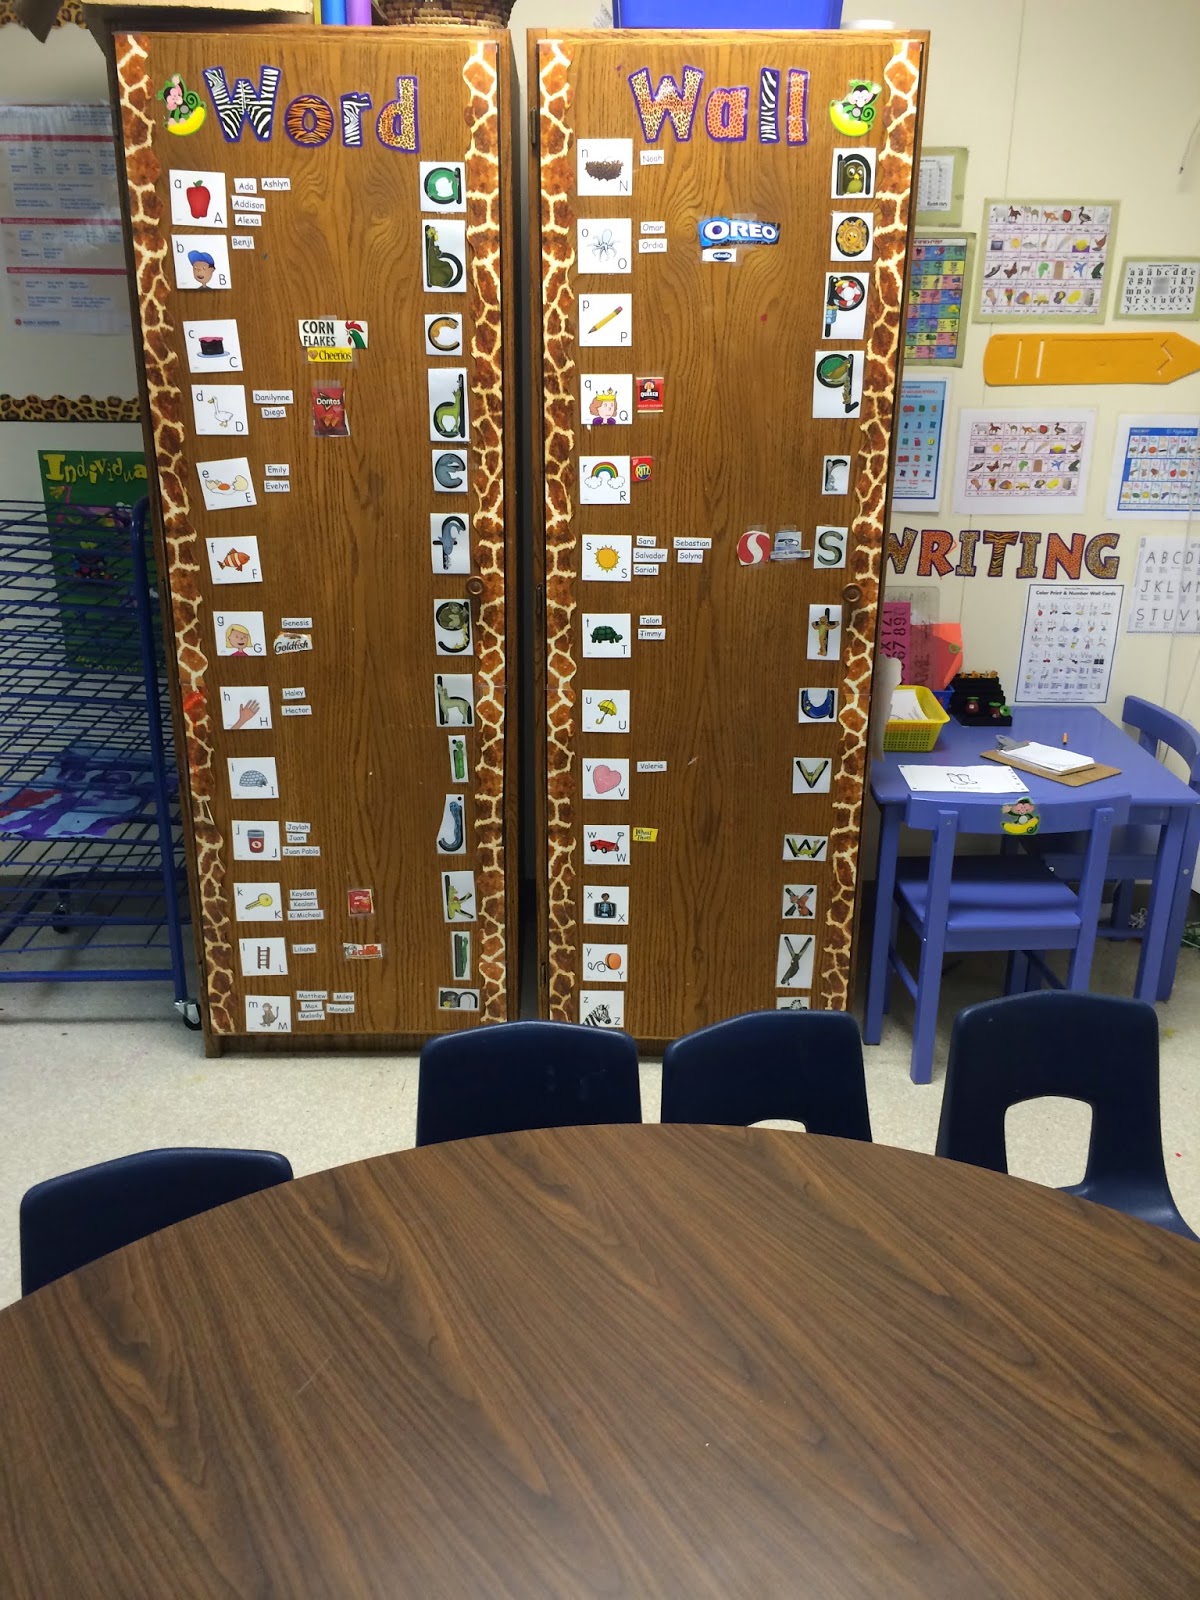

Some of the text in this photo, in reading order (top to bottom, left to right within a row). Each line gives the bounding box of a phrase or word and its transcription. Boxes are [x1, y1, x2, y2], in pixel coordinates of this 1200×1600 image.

[202, 65, 420, 153] Word
[627, 65, 810, 146] Wall
[581, 149, 589, 158] n
[642, 154, 663, 163] Noah
[174, 179, 182, 189] a
[238, 183, 254, 191] Ada
[263, 180, 289, 189] Ashlyn
[619, 181, 628, 191] N
[233, 200, 265, 210] Addison
[214, 212, 223, 224] A
[237, 216, 260, 225] Alexa
[642, 223, 663, 231] Omar
[704, 221, 777, 241] OREO
[176, 241, 184, 253] b
[232, 238, 252, 248] Benji
[618, 258, 627, 269] O
[219, 274, 227, 285] B
[583, 299, 590, 311] p
[302, 321, 334, 334] CORN
[303, 335, 336, 347] FLAKES
[620, 332, 627, 342] P
[318, 349, 352, 361] Cheerios
[229, 356, 239, 368] C
[584, 379, 591, 390] q
[196, 390, 204, 402] d
[316, 397, 341, 406] Doritos
[264, 408, 284, 418] Diego
[619, 411, 628, 421] Q
[236, 421, 244, 432] D
[267, 466, 287, 475] Emily
[583, 464, 587, 472] r
[636, 465, 651, 478] RITZ
[202, 469, 210, 479] e
[265, 482, 289, 491] Evelyn
[245, 492, 252, 503] E
[619, 491, 626, 501] R
[638, 538, 655, 546] Sara
[675, 540, 710, 548] Sebastian
[210, 542, 215, 553] f
[634, 551, 665, 560] Salvador
[888, 527, 1120, 580] WRITING
[252, 569, 258, 579] F
[621, 569, 628, 578] S
[217, 616, 224, 626] g
[283, 619, 309, 627] Genesis
[586, 618, 590, 628] t
[253, 644, 262, 653] G
[274, 639, 309, 654] Goldfish
[621, 645, 628, 654] T
[223, 692, 230, 701] h
[285, 706, 309, 714] Hector
[259, 717, 269, 727] H
[619, 720, 627, 730] U
[618, 788, 626, 797] V
[235, 824, 240, 836] j
[271, 848, 277, 858] J
[616, 853, 627, 862] W
[237, 887, 243, 896] k
[274, 910, 281, 919] K
[618, 914, 626, 922] X
[586, 948, 592, 956] y
[279, 965, 284, 973] L
[618, 971, 624, 979] Y
[249, 1000, 258, 1009] m
[278, 1022, 288, 1030] M
[614, 1017, 620, 1025] Z
